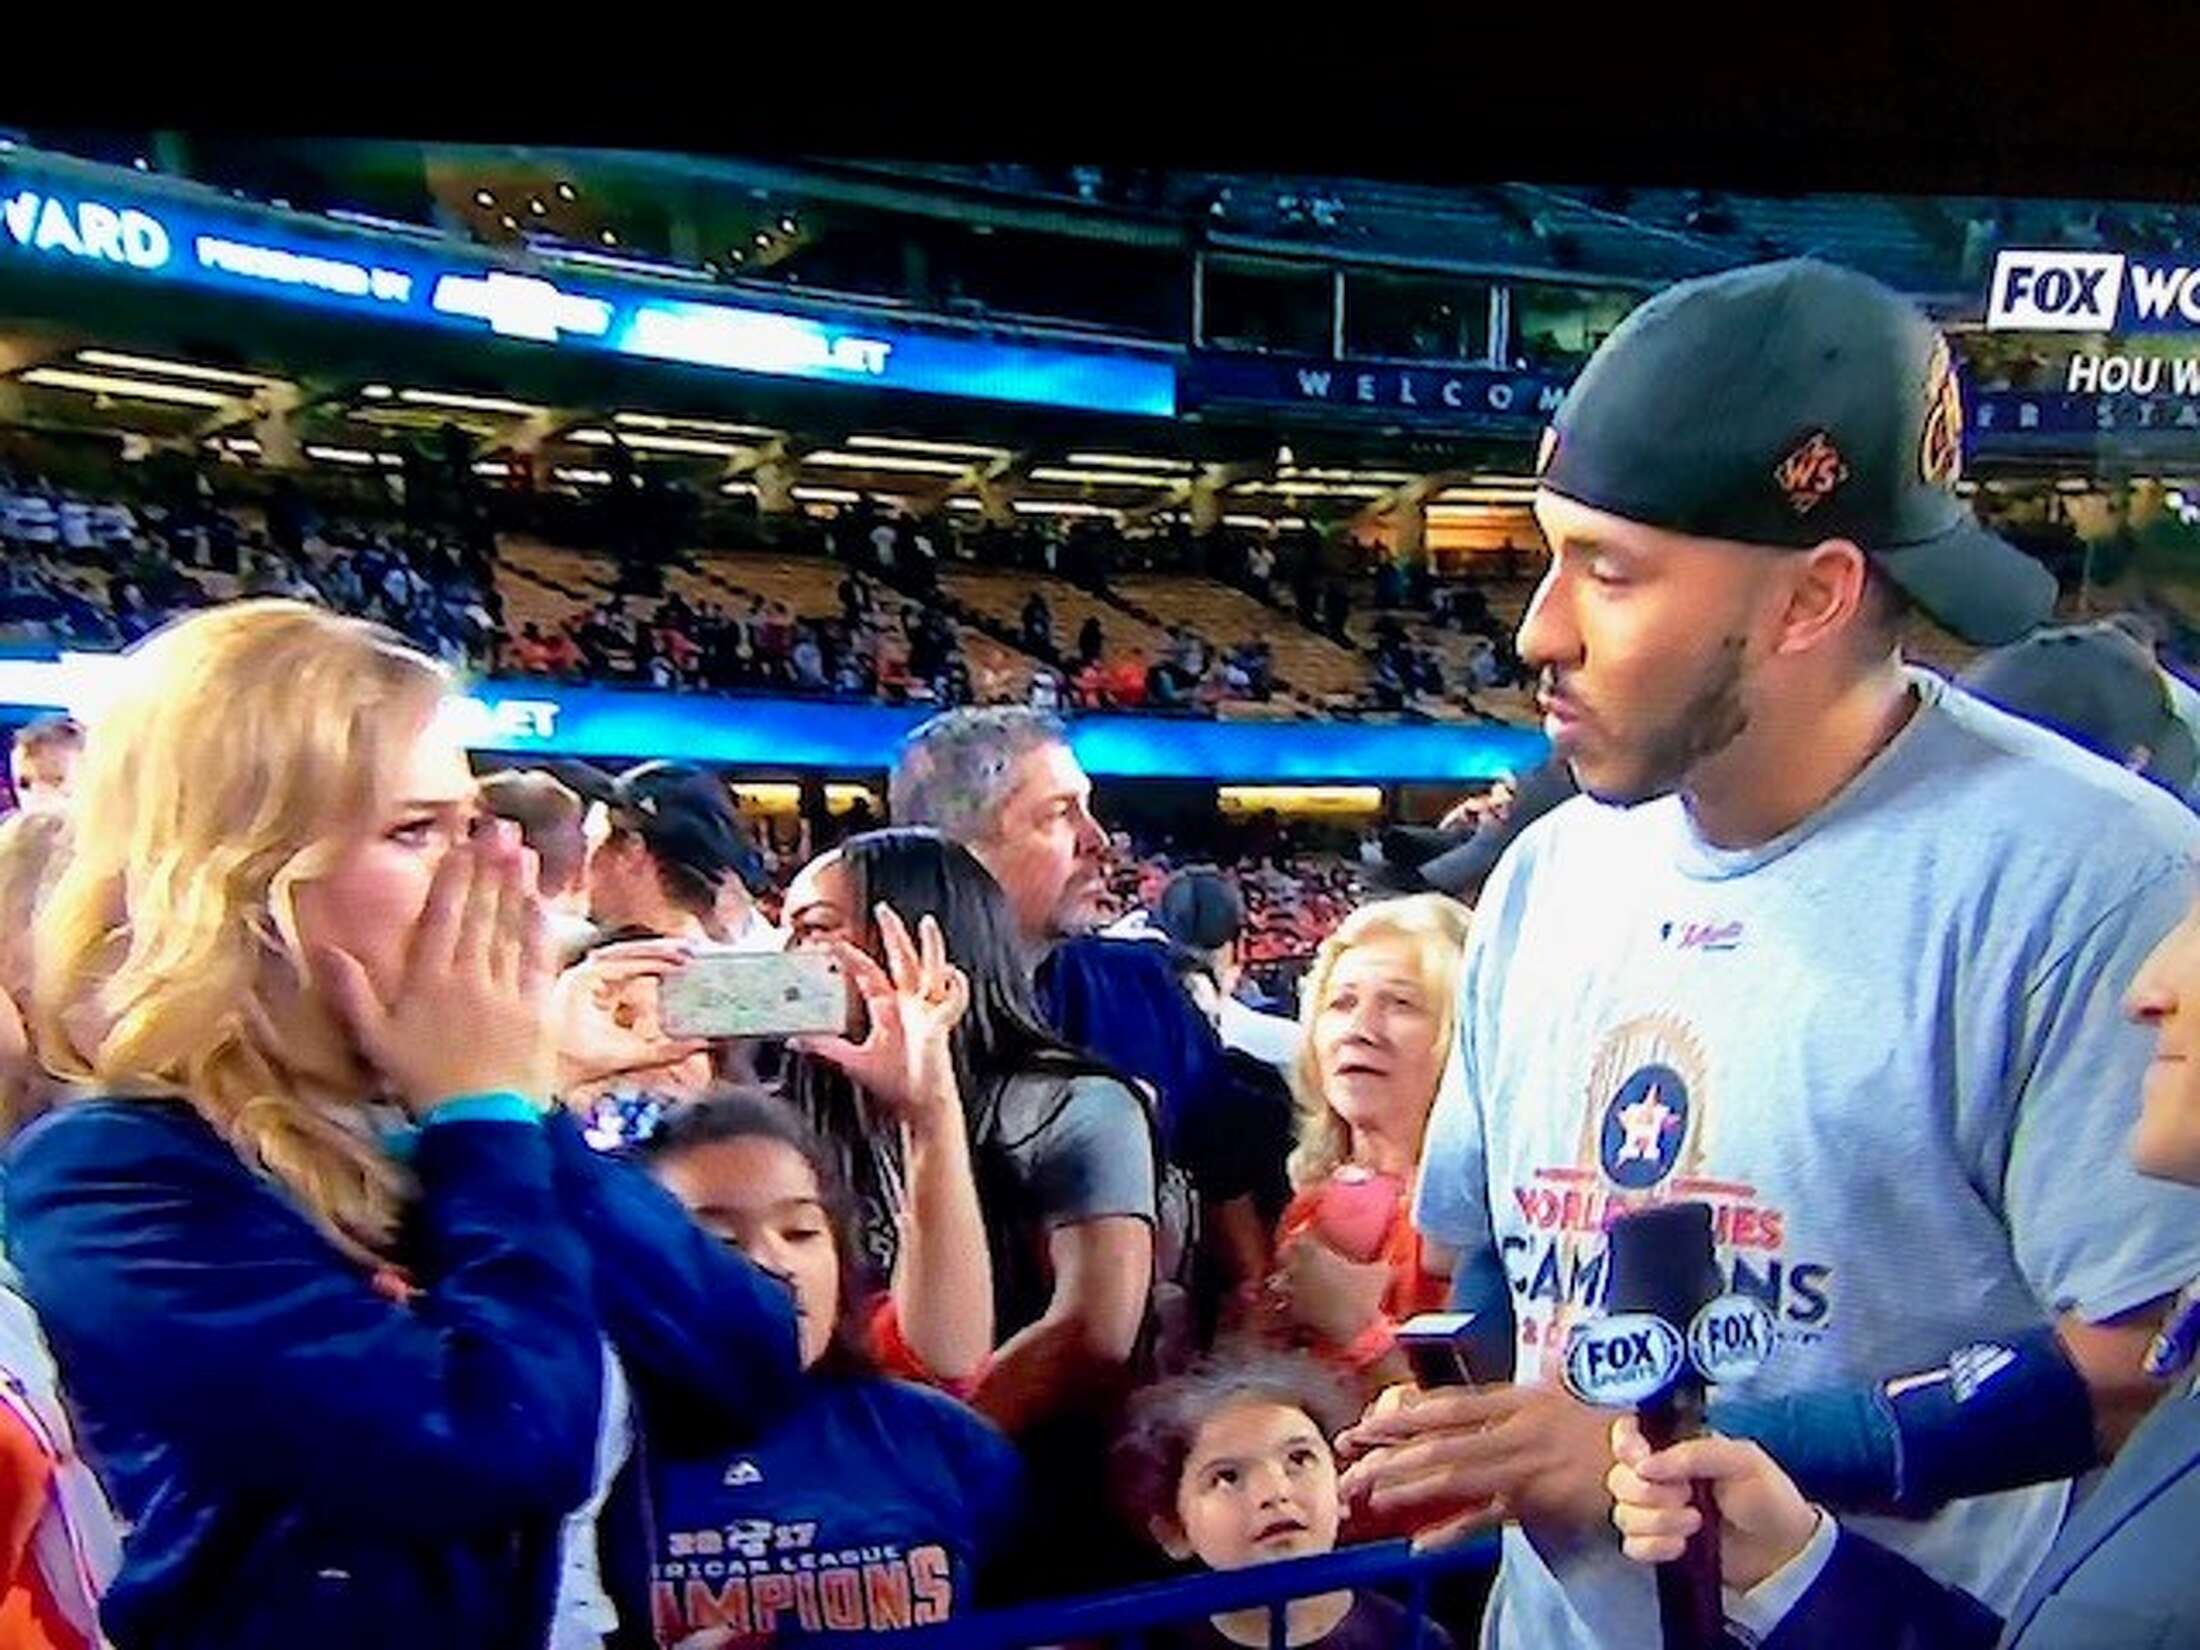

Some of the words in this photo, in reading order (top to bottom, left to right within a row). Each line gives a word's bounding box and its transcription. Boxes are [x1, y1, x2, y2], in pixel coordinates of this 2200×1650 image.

[2002, 266, 2108, 315] FOX
[2067, 354, 2161, 395] HOU
[1586, 1328, 1655, 1377] FOX
[1708, 1312, 1758, 1354] FOX
